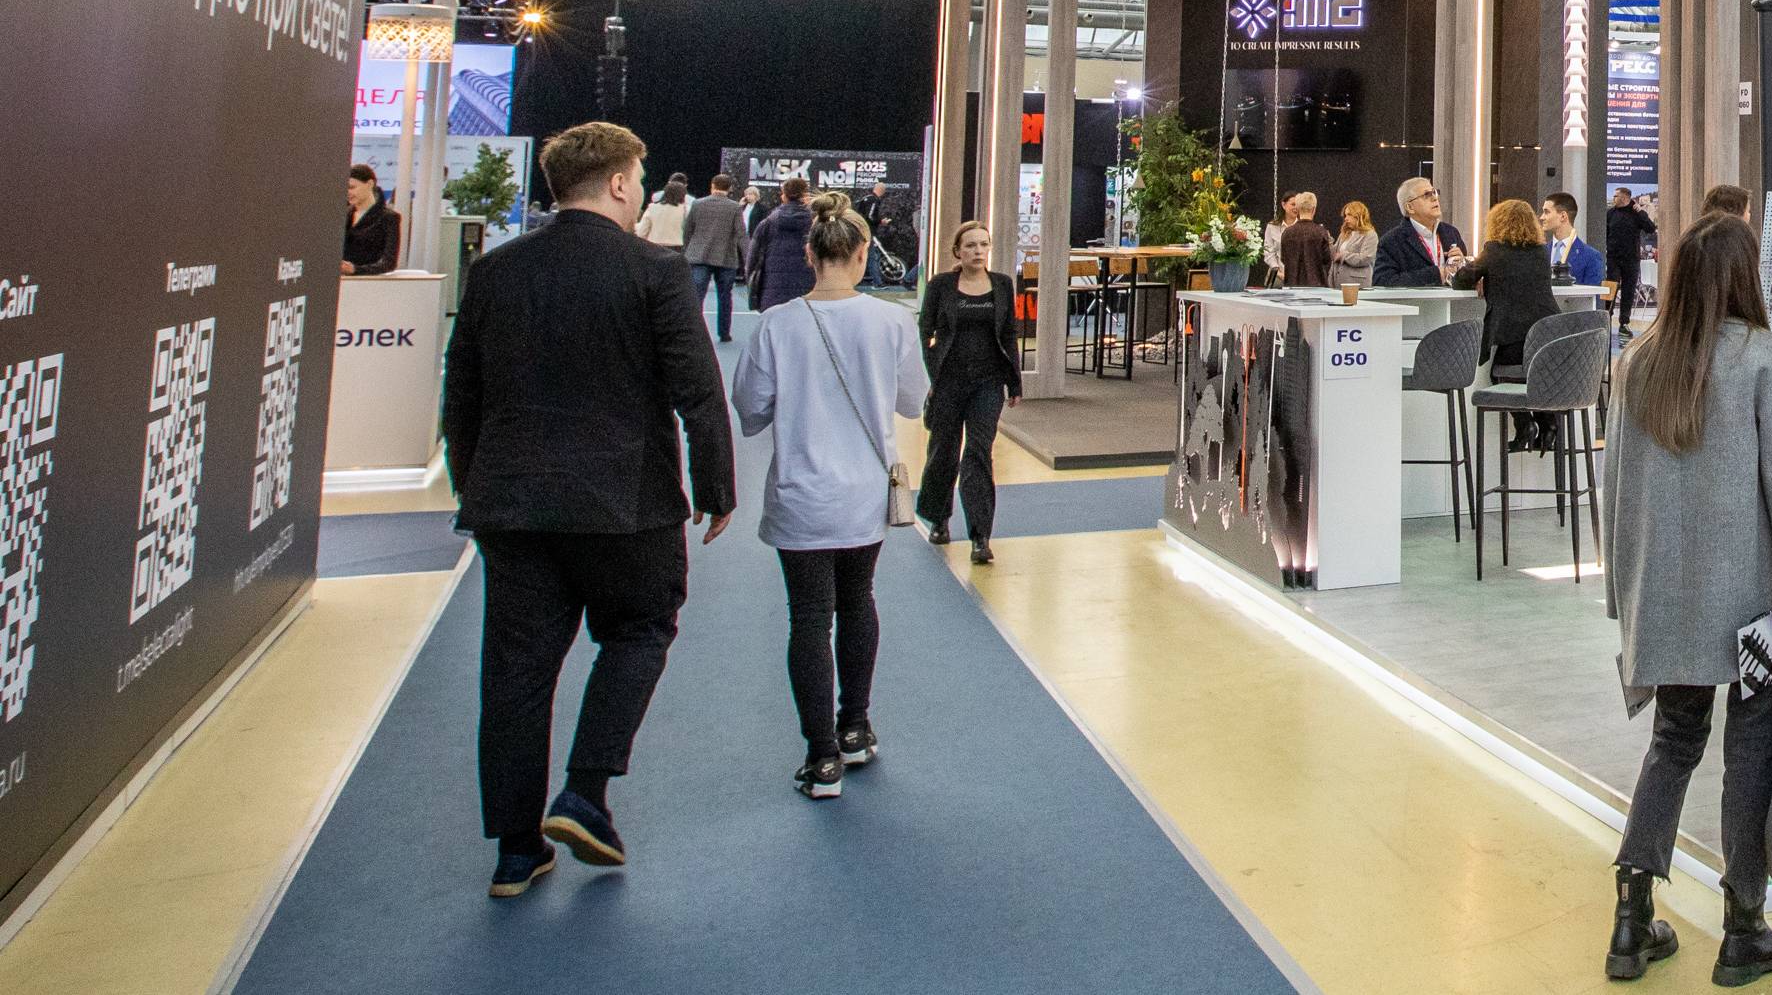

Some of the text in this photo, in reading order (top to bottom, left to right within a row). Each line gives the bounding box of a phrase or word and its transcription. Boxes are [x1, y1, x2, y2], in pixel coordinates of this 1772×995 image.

[1242, 41, 1273, 50] CREATE
[1275, 41, 1322, 50] IMPRESSIVE
[1324, 40, 1361, 50] RESULTS
[1611, 60, 1657, 74] РЕКС
[1740, 88, 1749, 96] FD
[855, 161, 887, 172] 2025
[0, 274, 39, 321] Сайт
[1337, 329, 1363, 343] FC
[1331, 352, 1368, 366] 050
